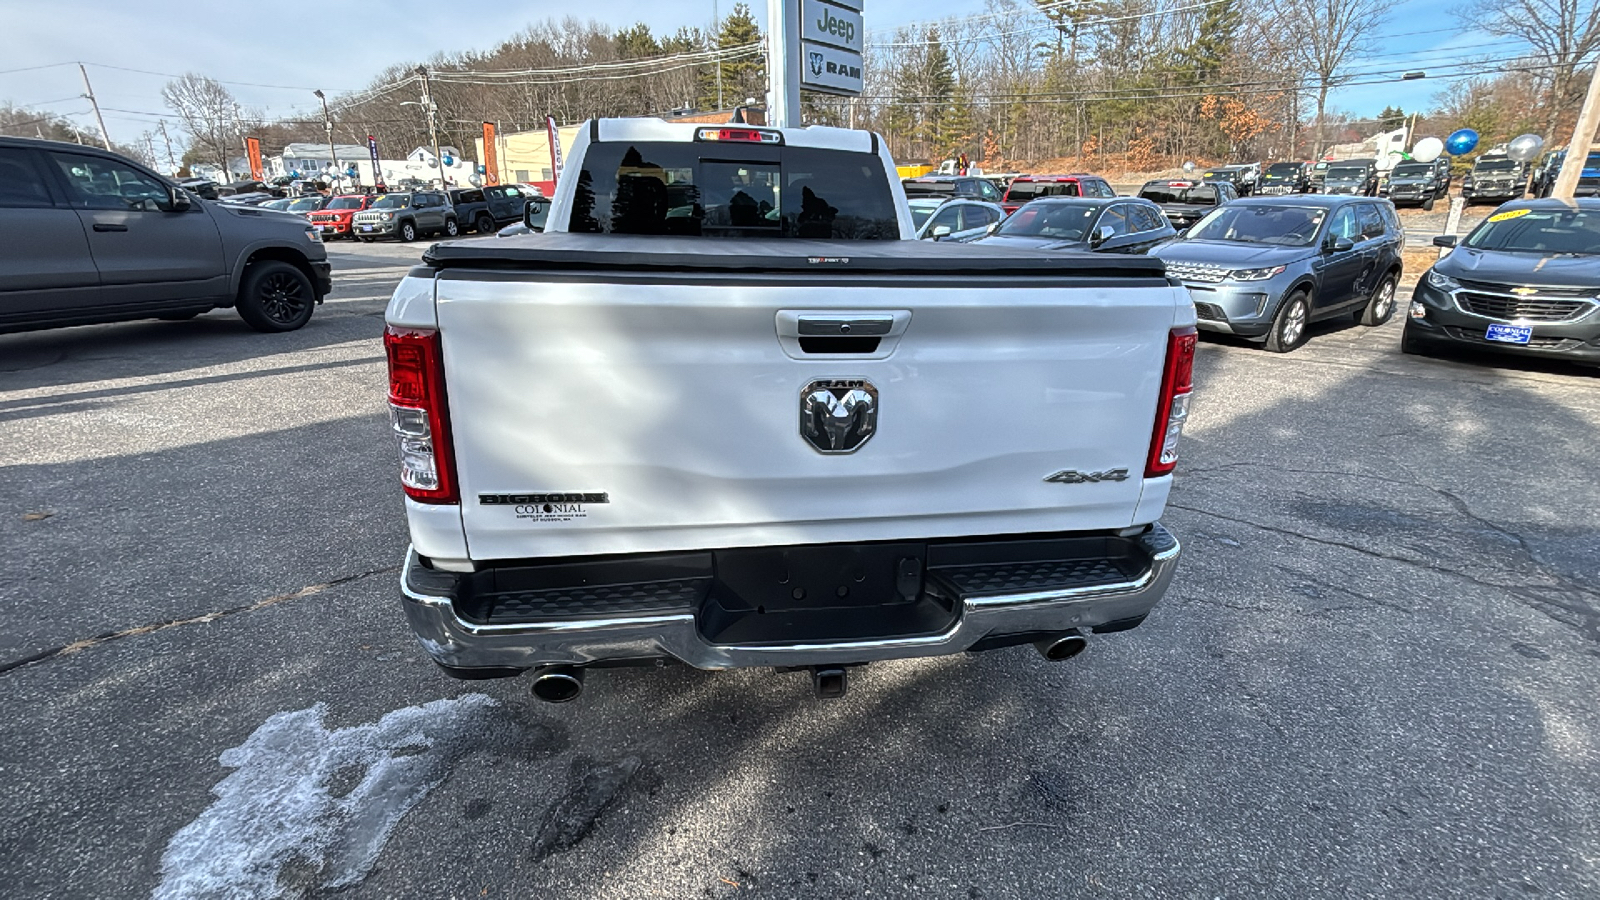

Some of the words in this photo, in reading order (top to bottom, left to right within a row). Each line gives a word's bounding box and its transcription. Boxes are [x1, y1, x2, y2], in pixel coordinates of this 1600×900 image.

[817, 8, 854, 44] Jeep
[826, 61, 860, 80] RAM
[816, 380, 864, 388] RAM
[515, 504, 586, 514] COLONIAL
